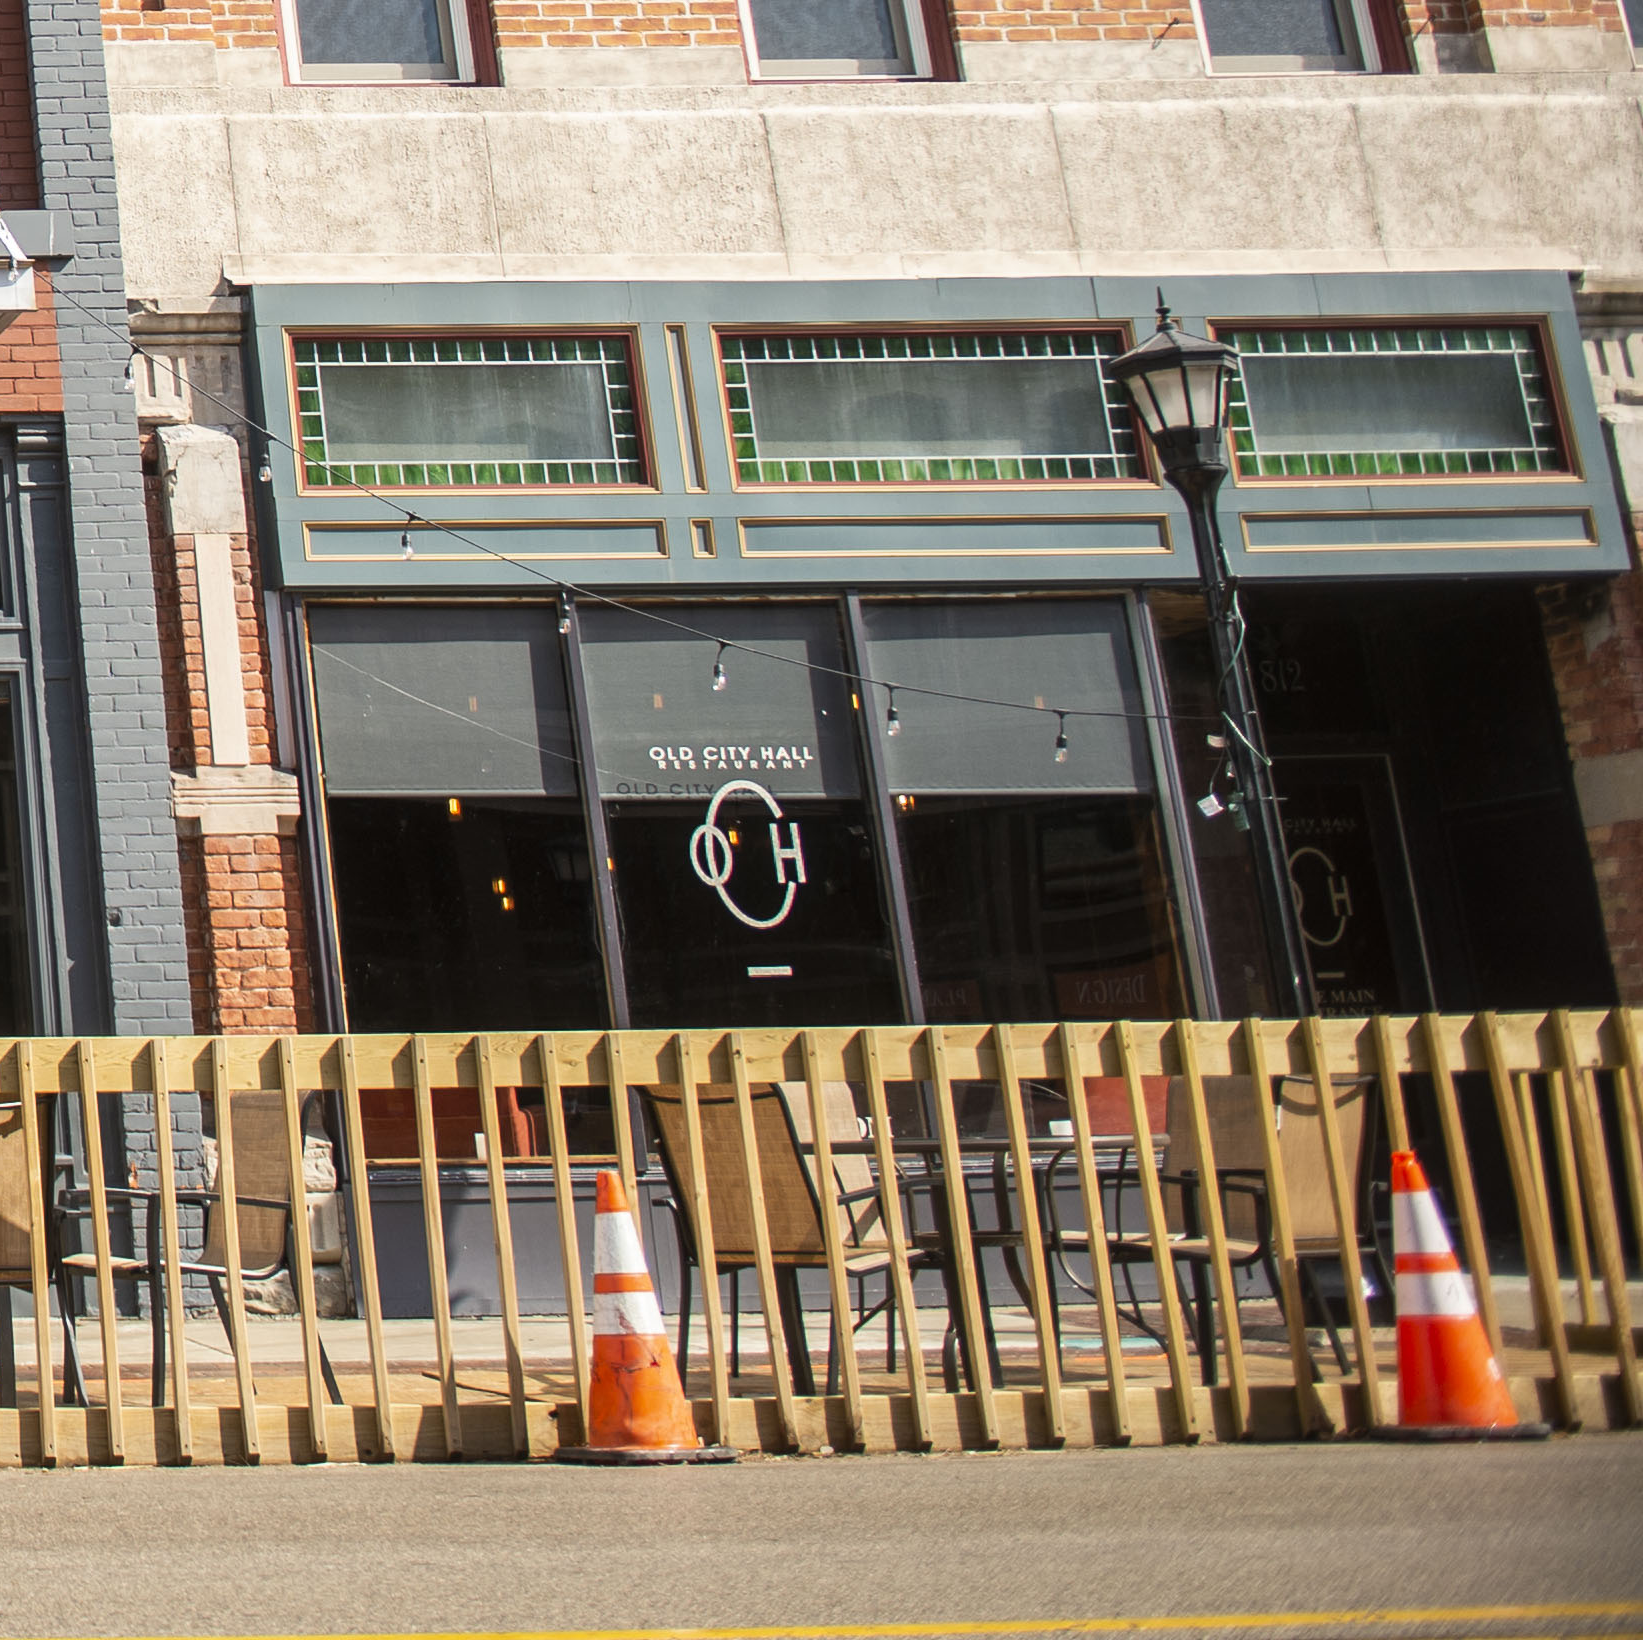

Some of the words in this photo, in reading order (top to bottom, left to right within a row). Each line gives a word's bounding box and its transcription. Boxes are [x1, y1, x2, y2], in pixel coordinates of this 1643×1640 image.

[1258, 659, 1306, 692] 812
[649, 746, 693, 760] OLD
[703, 746, 750, 760] CITY
[761, 746, 813, 760] HALL
[657, 760, 807, 770] RESTAURANT
[1331, 989, 1376, 1003] MAIN
